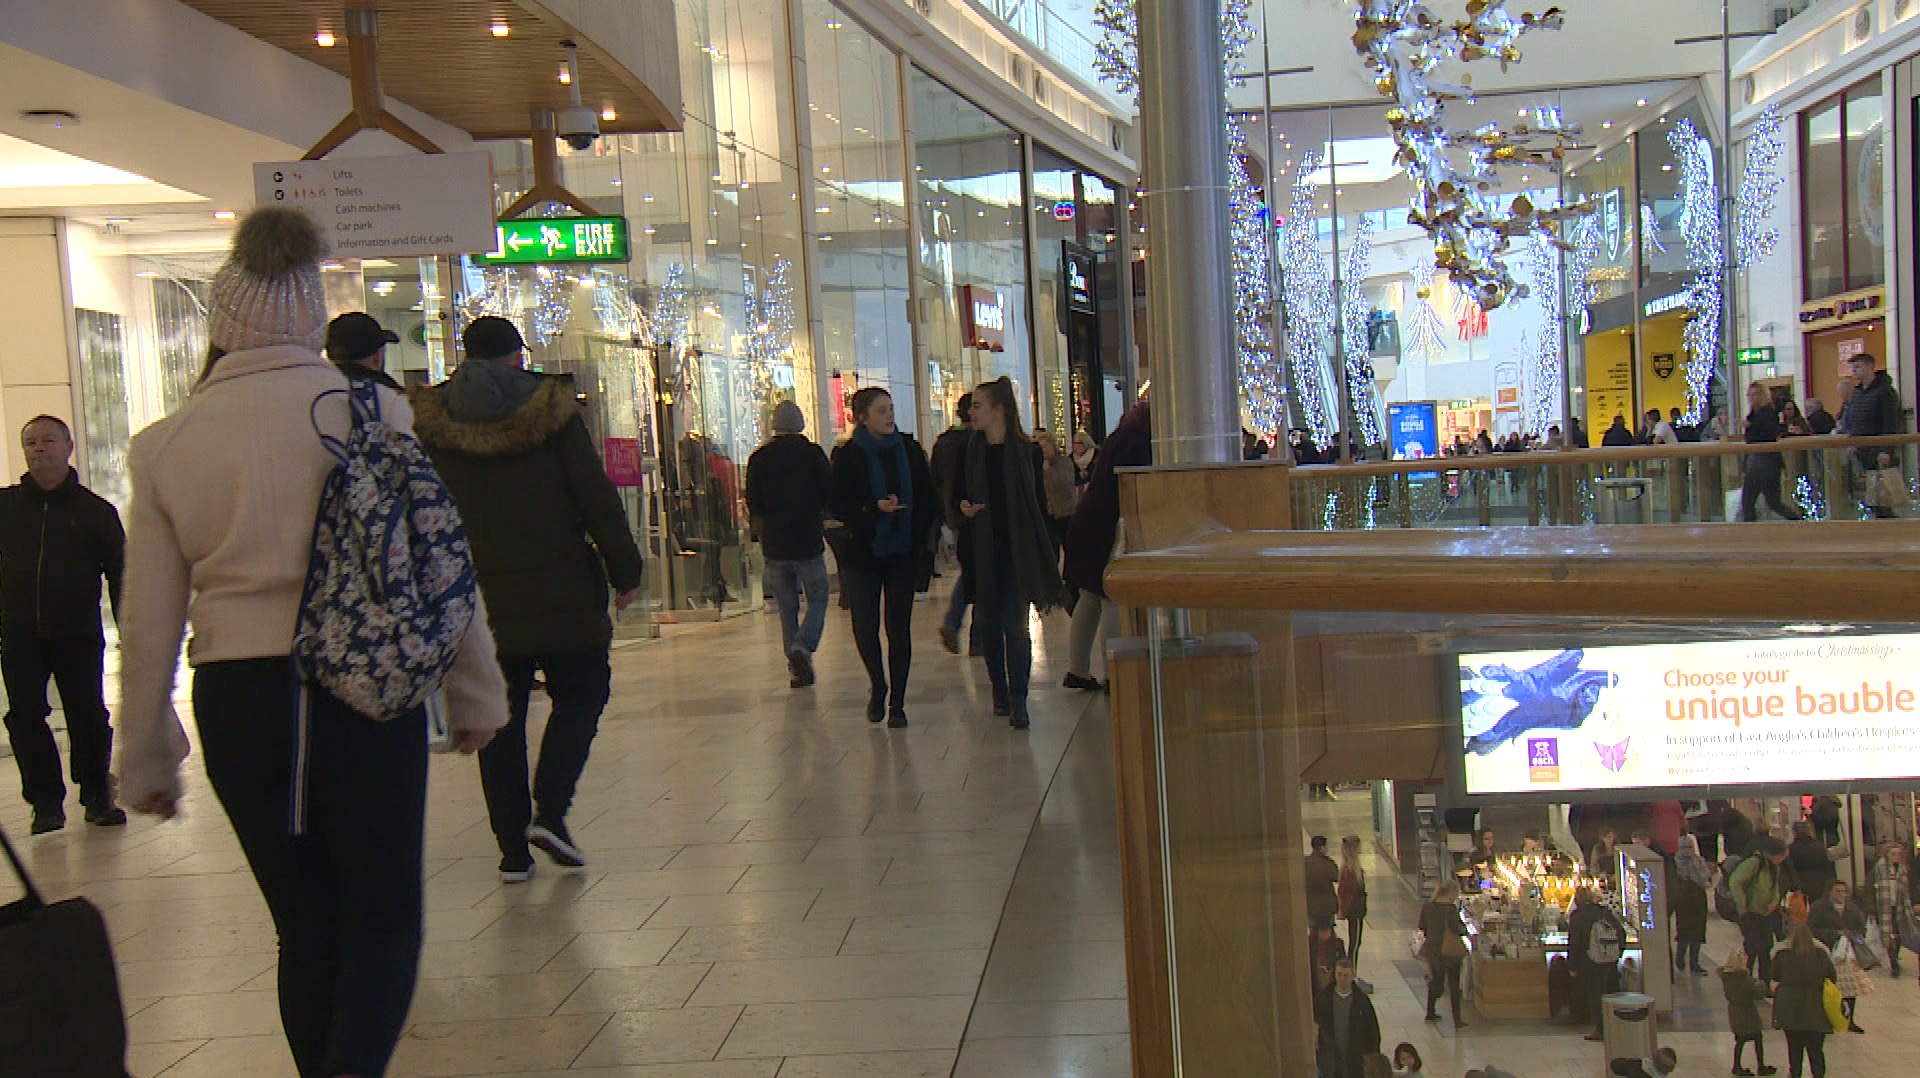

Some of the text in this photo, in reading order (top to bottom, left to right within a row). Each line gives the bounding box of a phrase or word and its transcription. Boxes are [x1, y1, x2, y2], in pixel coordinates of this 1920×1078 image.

[332, 169, 353, 180] Lifts
[334, 187, 364, 197] Toilets
[335, 202, 402, 215] Cash machines
[336, 220, 373, 232] Car park
[574, 223, 615, 239] FIRE
[337, 233, 454, 249] Information and Gift Cards
[575, 239, 613, 256] EXIT
[1663, 669, 1790, 689] Choose your
[1665, 680, 1916, 727] unique bauble
[1679, 734, 1722, 747] support
